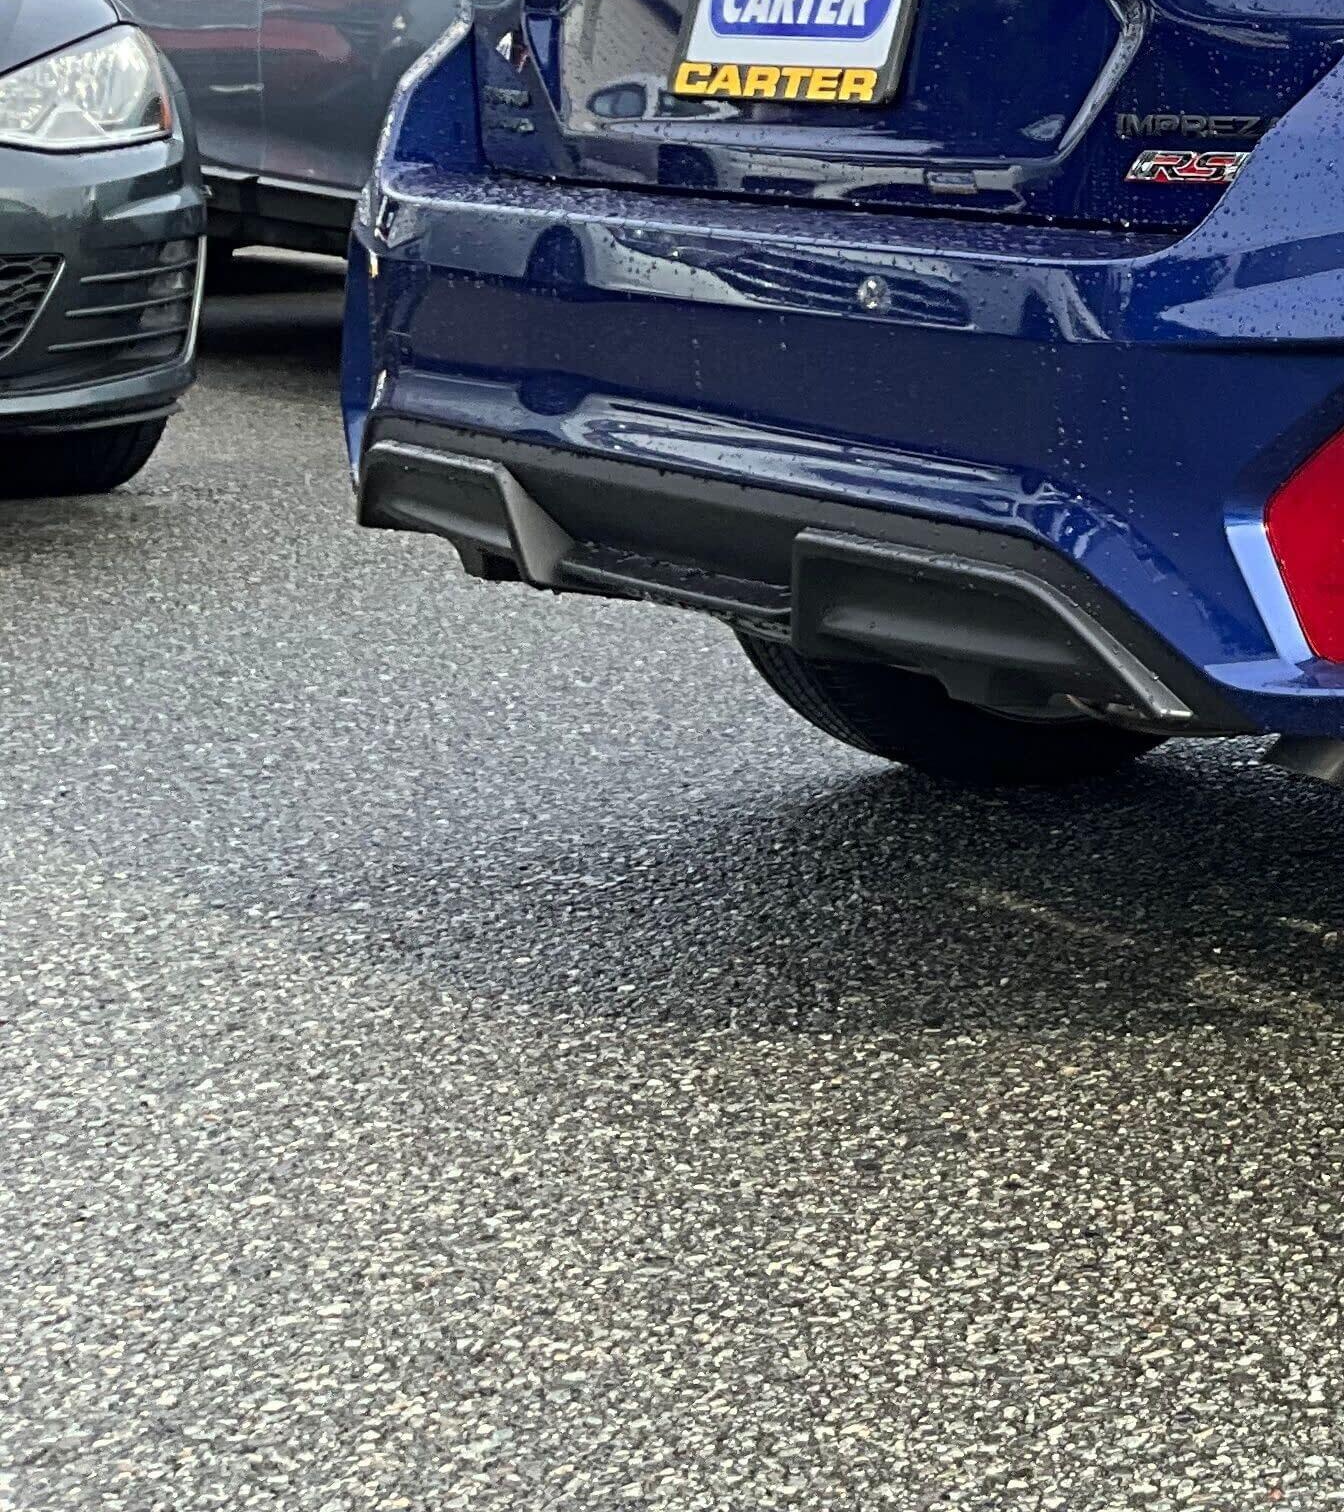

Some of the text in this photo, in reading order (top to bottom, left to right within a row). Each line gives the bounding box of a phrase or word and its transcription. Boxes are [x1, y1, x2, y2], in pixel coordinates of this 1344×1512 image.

[673, 61, 878, 102] CARTER
[1115, 112, 1281, 139] IMPREZ
[1126, 149, 1250, 183] RS
